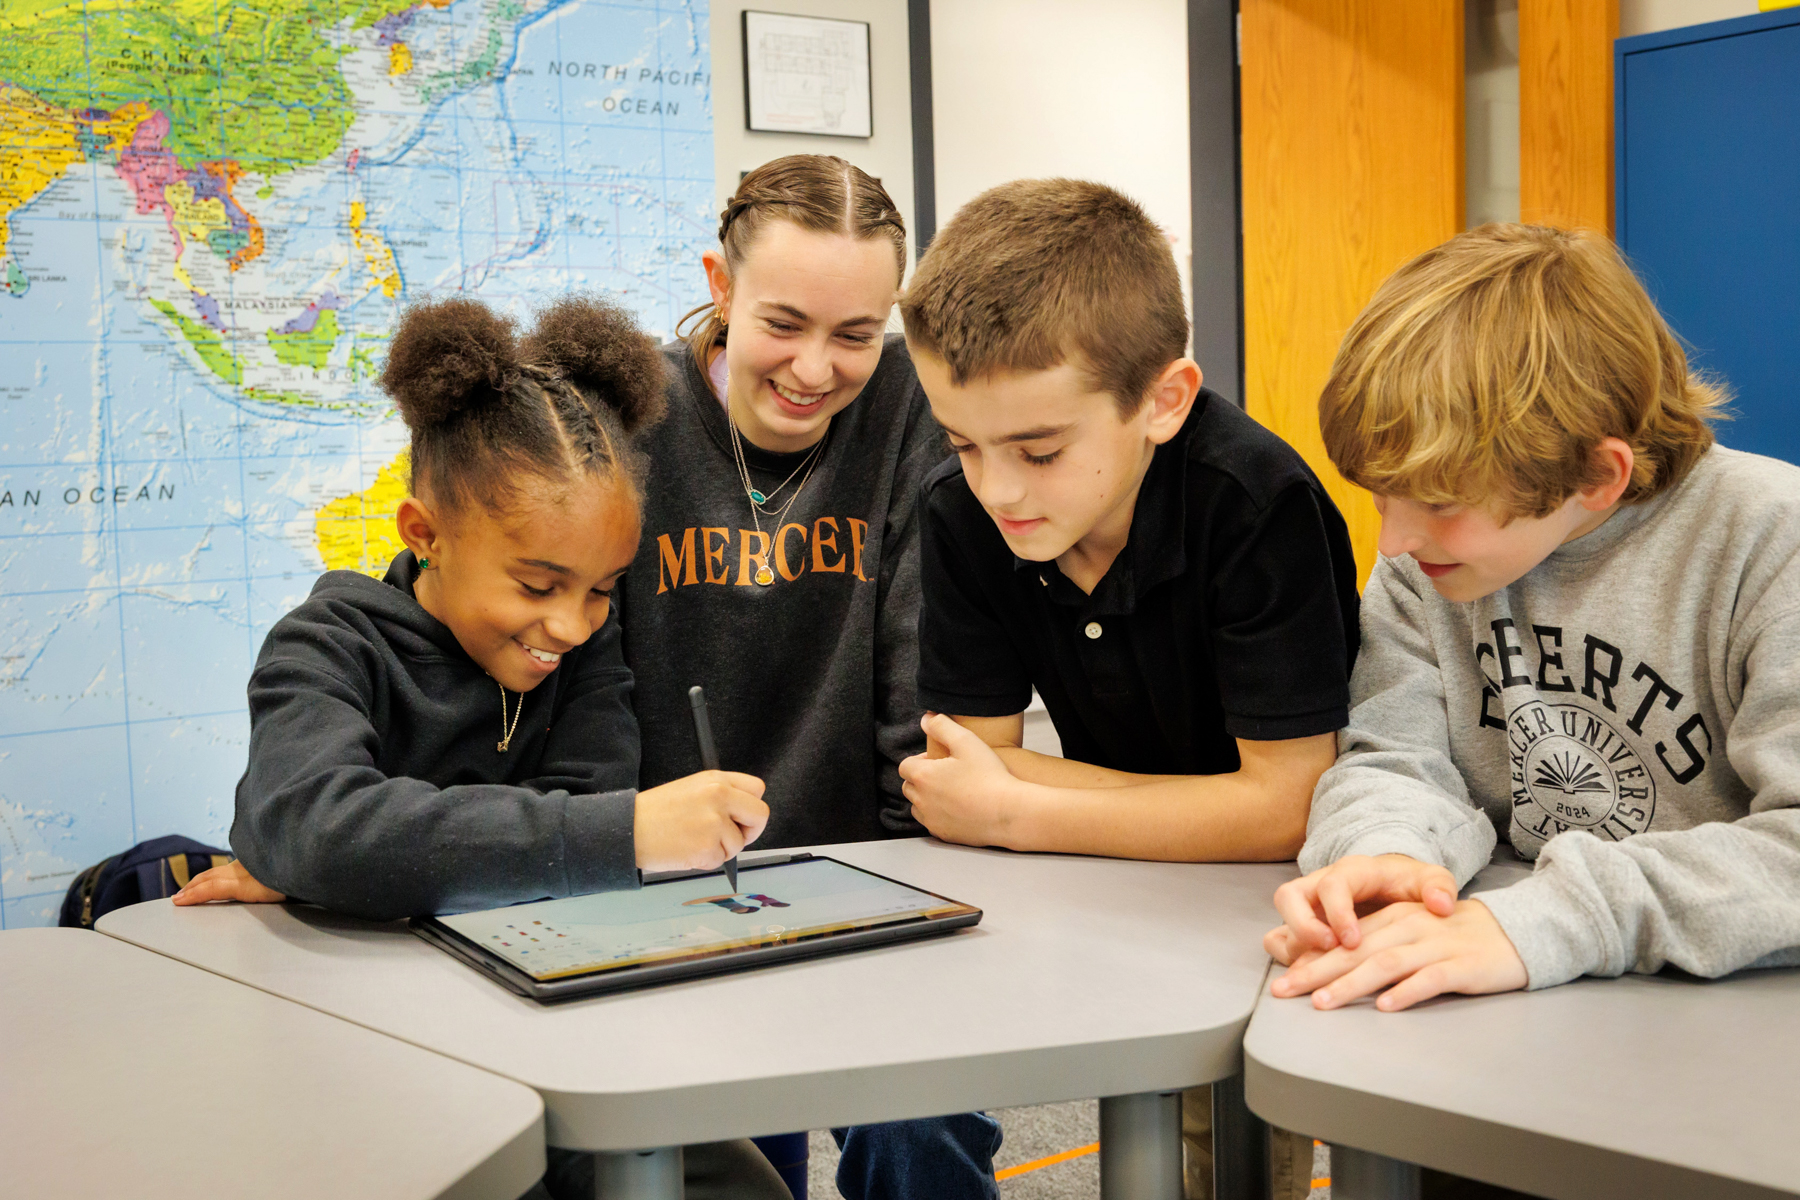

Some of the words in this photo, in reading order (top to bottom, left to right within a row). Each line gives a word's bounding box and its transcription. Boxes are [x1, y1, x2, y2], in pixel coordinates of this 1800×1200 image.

[548, 60, 628, 80] NORTH
[602, 96, 679, 116] OCEAN
[63, 484, 175, 505] OCEAN
[656, 516, 868, 595] MERCER
[1556, 802, 1591, 819] 2024
